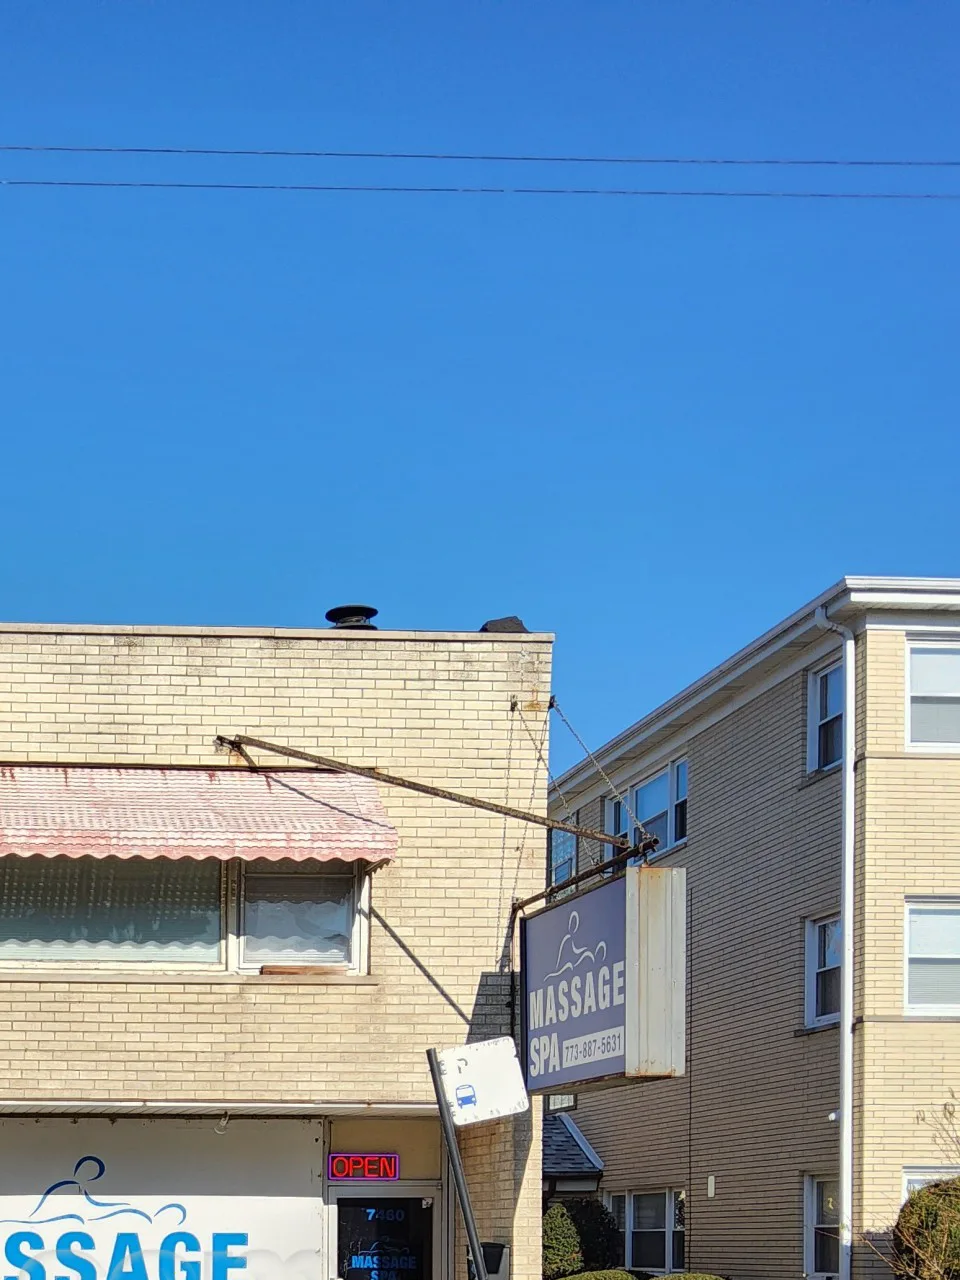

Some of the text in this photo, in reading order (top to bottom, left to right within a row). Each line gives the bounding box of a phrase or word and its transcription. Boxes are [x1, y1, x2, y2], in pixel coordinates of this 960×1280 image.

[530, 960, 625, 1031] MASSAGE
[530, 1031, 623, 1077] SPA 773-887-5631
[332, 1156, 395, 1178] OPEN
[351, 1255, 417, 1268] MASSAGE
